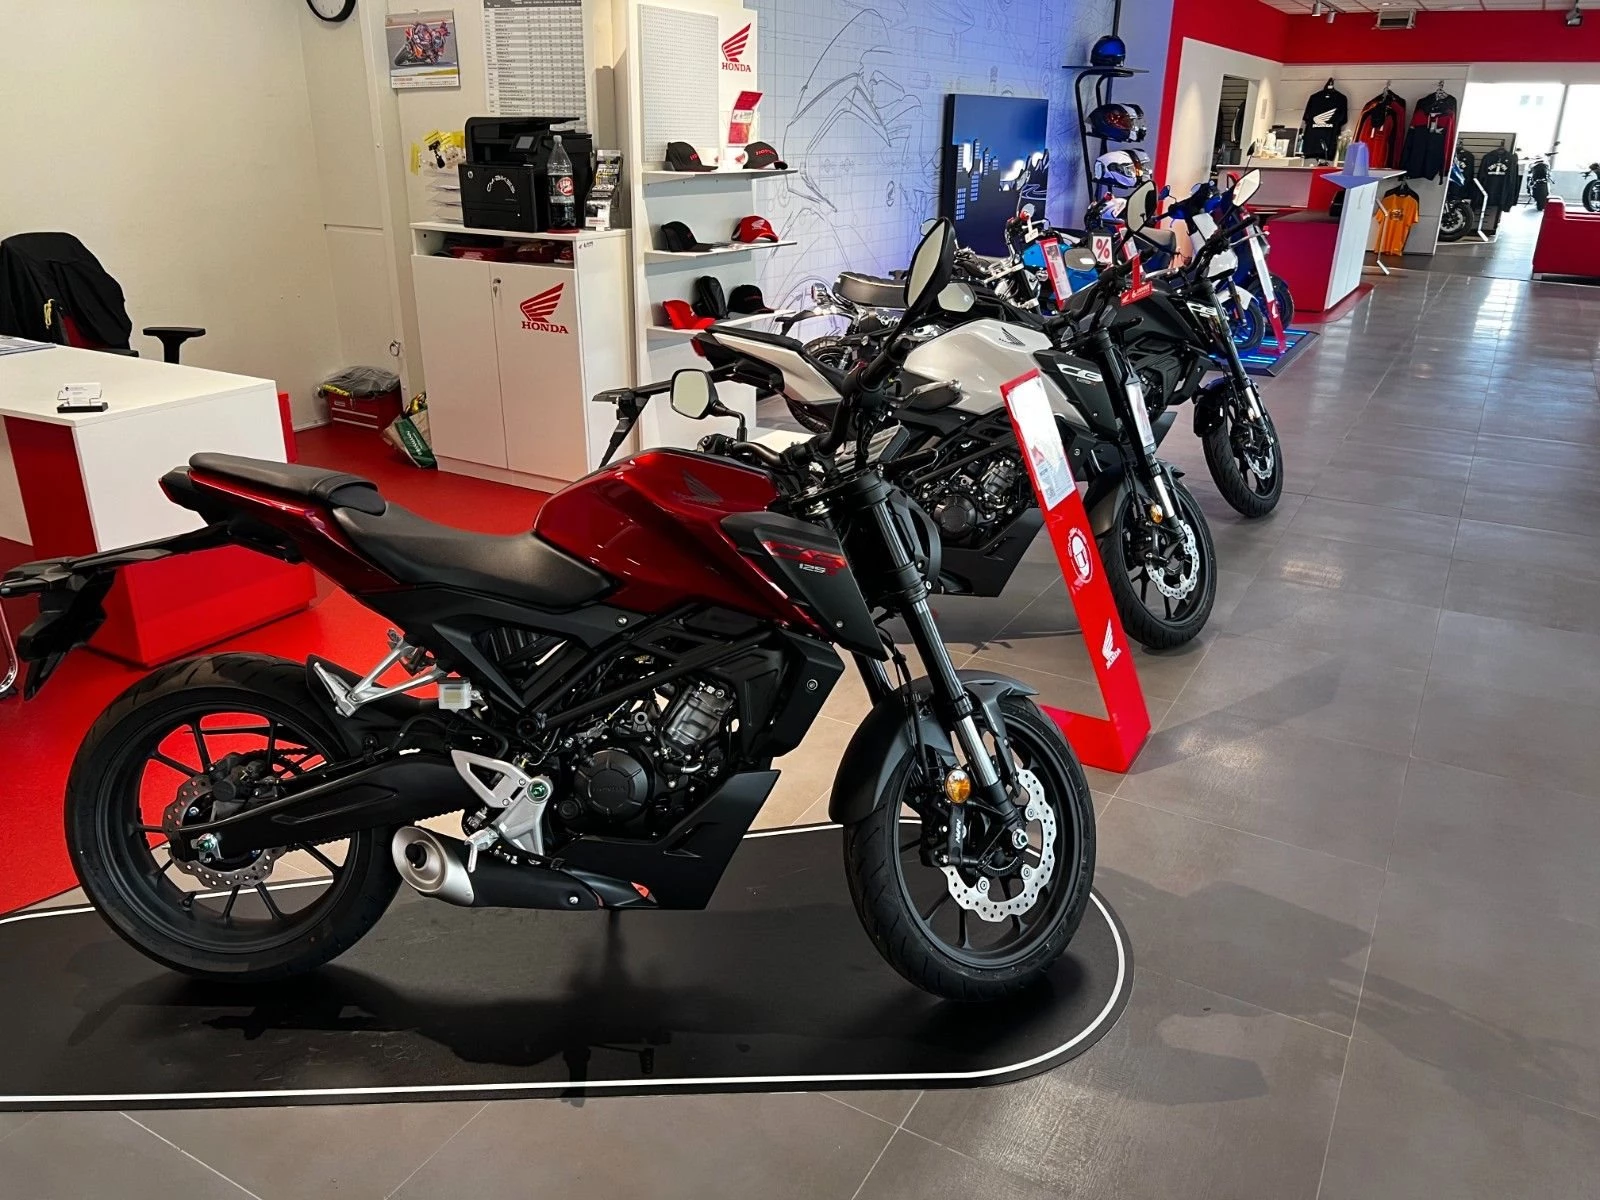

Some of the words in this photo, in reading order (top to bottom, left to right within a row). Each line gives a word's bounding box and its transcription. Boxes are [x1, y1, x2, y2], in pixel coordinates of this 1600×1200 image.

[721, 62, 752, 73] HONDA
[1096, 238, 1110, 259] %
[521, 320, 569, 335] HONDA
